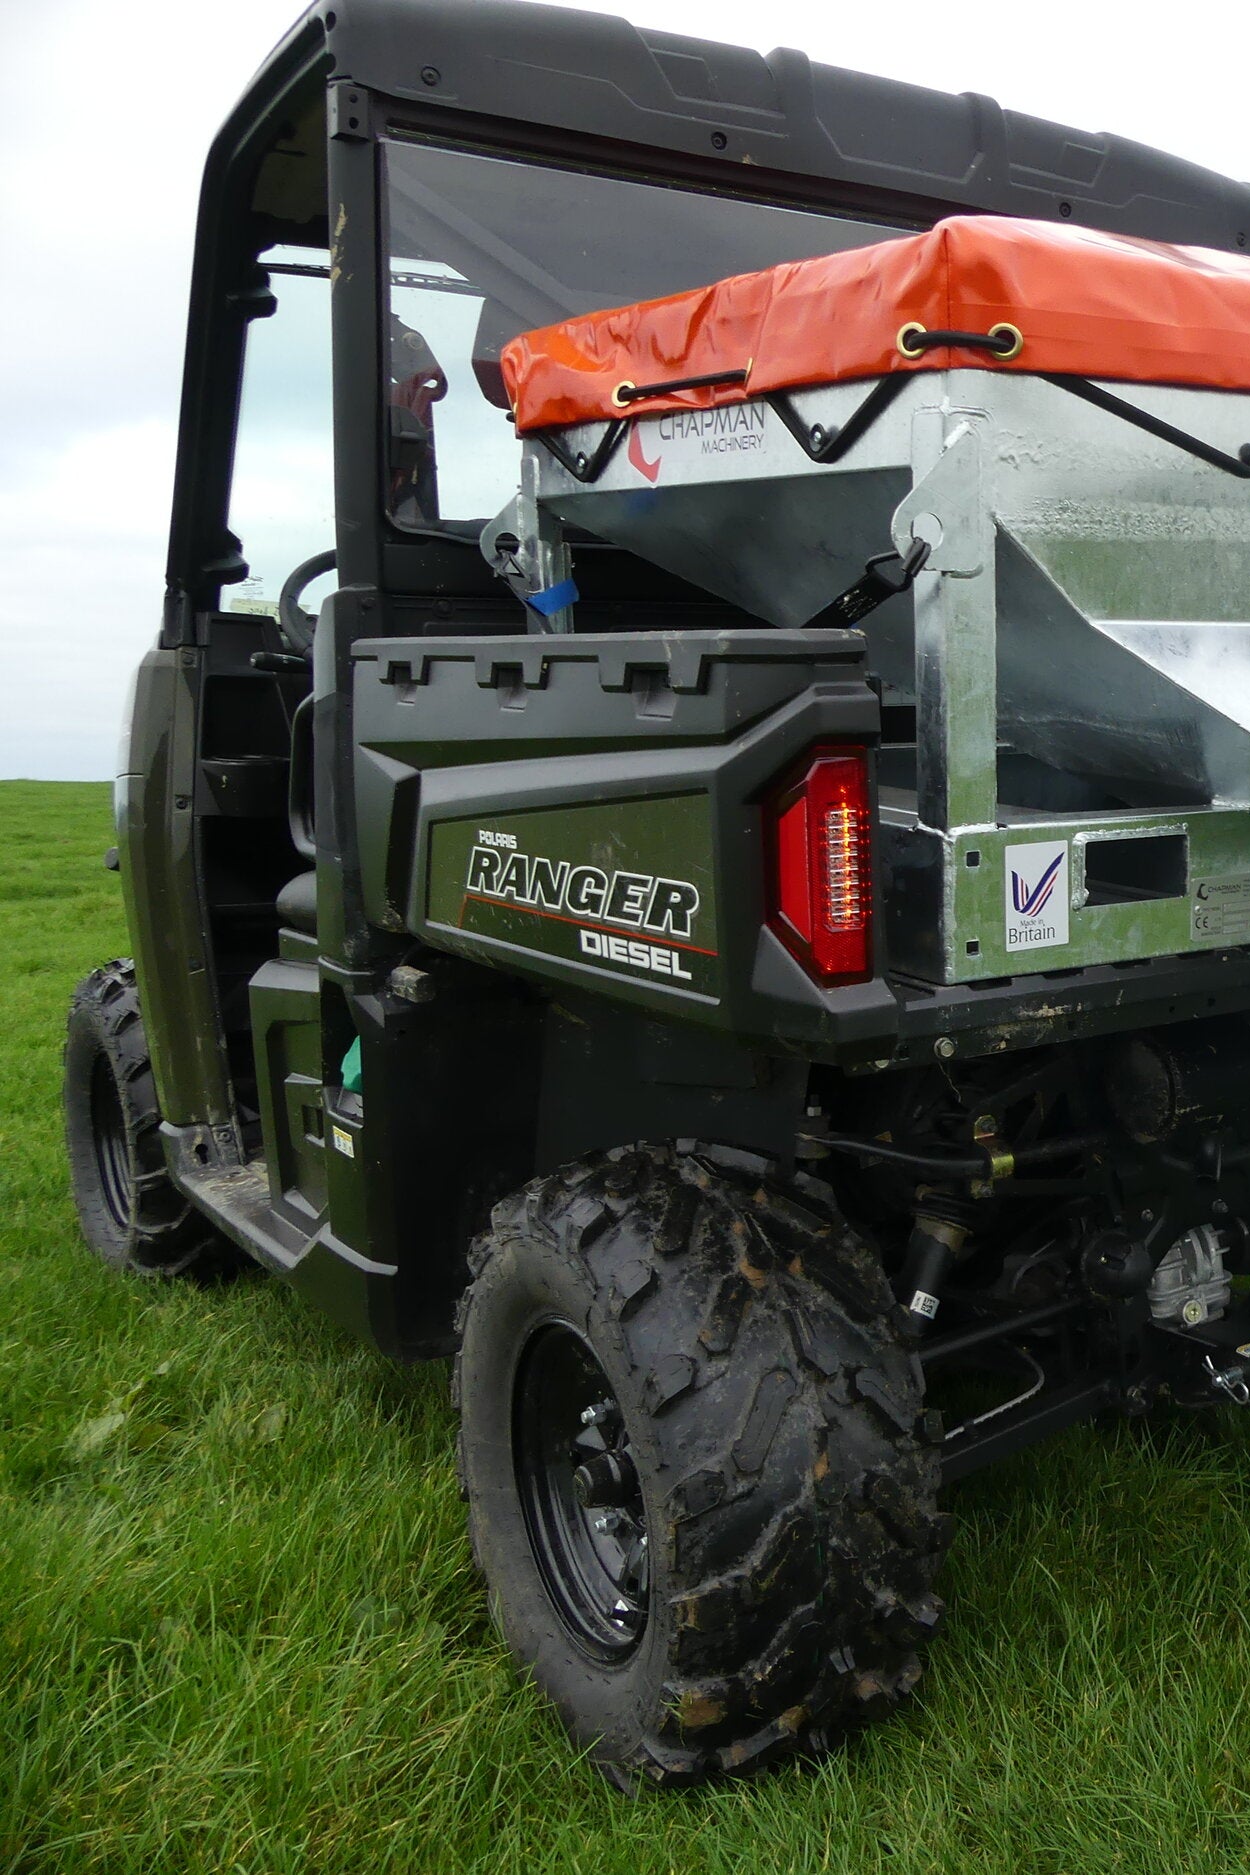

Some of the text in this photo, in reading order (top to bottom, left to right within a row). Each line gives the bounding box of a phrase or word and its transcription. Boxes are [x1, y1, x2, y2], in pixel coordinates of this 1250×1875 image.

[659, 400, 765, 440] CHAPMAN
[701, 434, 764, 455] MACHINERY
[478, 829, 518, 850] POLARIS
[466, 845, 700, 938] RANGER
[1008, 923, 1056, 944] Britain
[1020, 919, 1036, 927] Made
[579, 929, 692, 980] DIESEL
